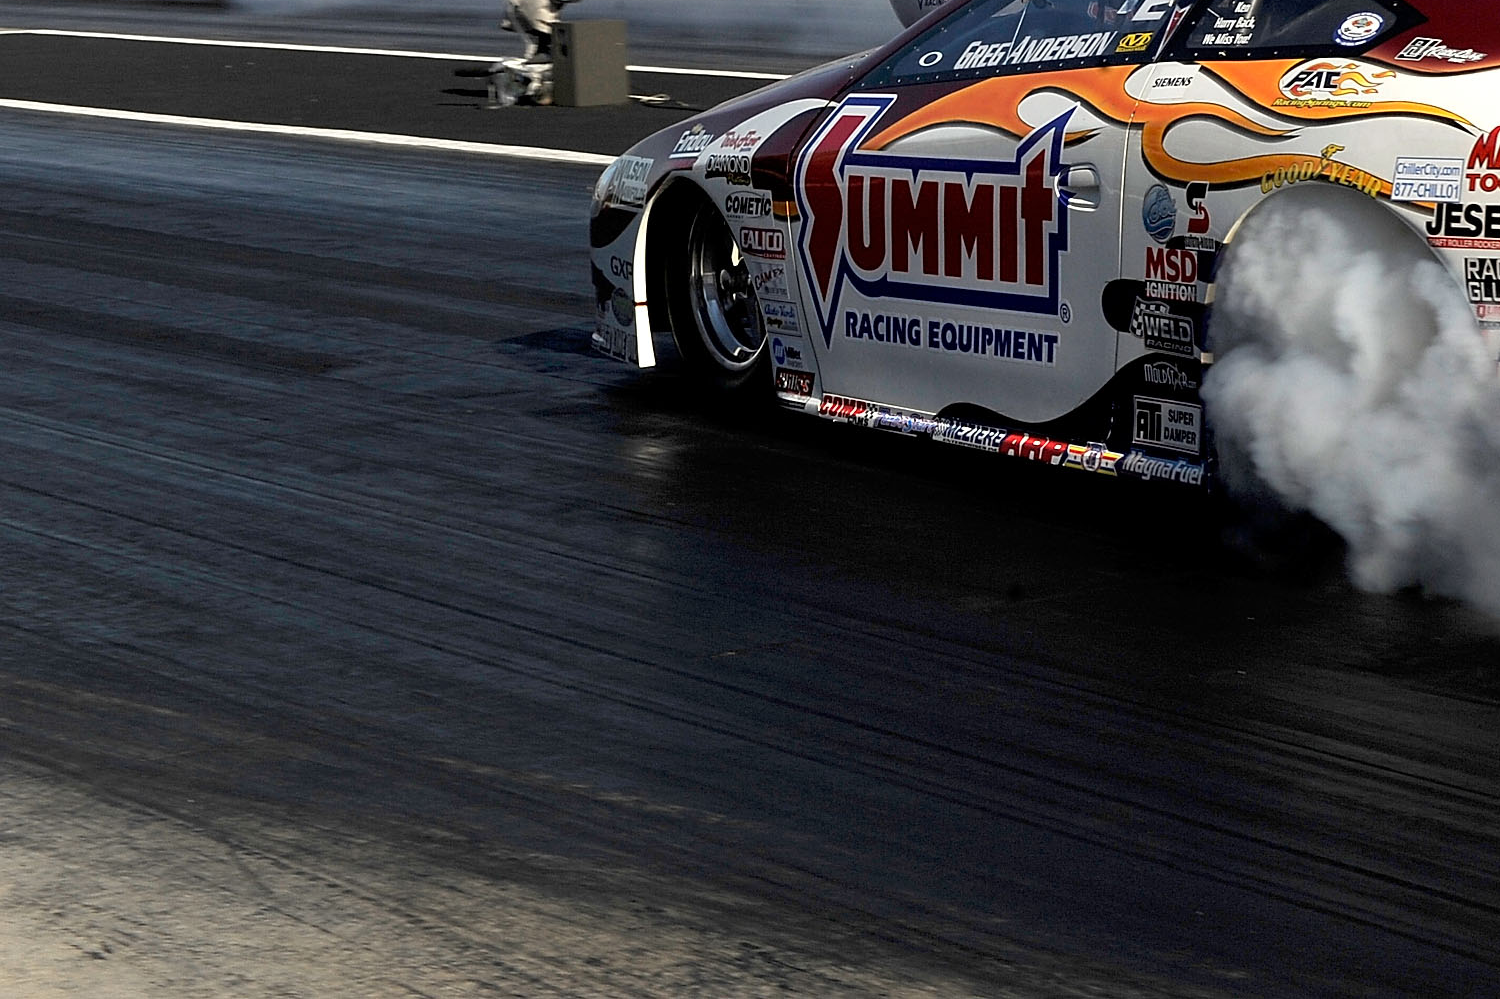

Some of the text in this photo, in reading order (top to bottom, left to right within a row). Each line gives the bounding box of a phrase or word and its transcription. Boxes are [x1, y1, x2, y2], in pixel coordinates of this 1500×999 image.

[952, 30, 1118, 70] GREG ANDERSON
[1152, 76, 1193, 88] SIEMENS
[1395, 162, 1460, 177] ChillerCity.com
[1394, 182, 1459, 200] 877-CHILL01
[725, 193, 772, 216] COMETIC
[803, 114, 1053, 302] SUMMIT
[741, 229, 783, 251] CALICO
[1145, 246, 1197, 284] MSD
[1145, 281, 1196, 302] IGNITION
[845, 310, 1059, 364] RACING EQUIPMENT
[1144, 315, 1192, 342] WELD
[1146, 339, 1192, 352] RACING
[818, 394, 868, 418] COMP
[1167, 408, 1195, 427] SUPER
[1163, 427, 1197, 446] DAMPER
[1000, 432, 1069, 465] ARP
[1122, 449, 1205, 486] MagnaFuel
